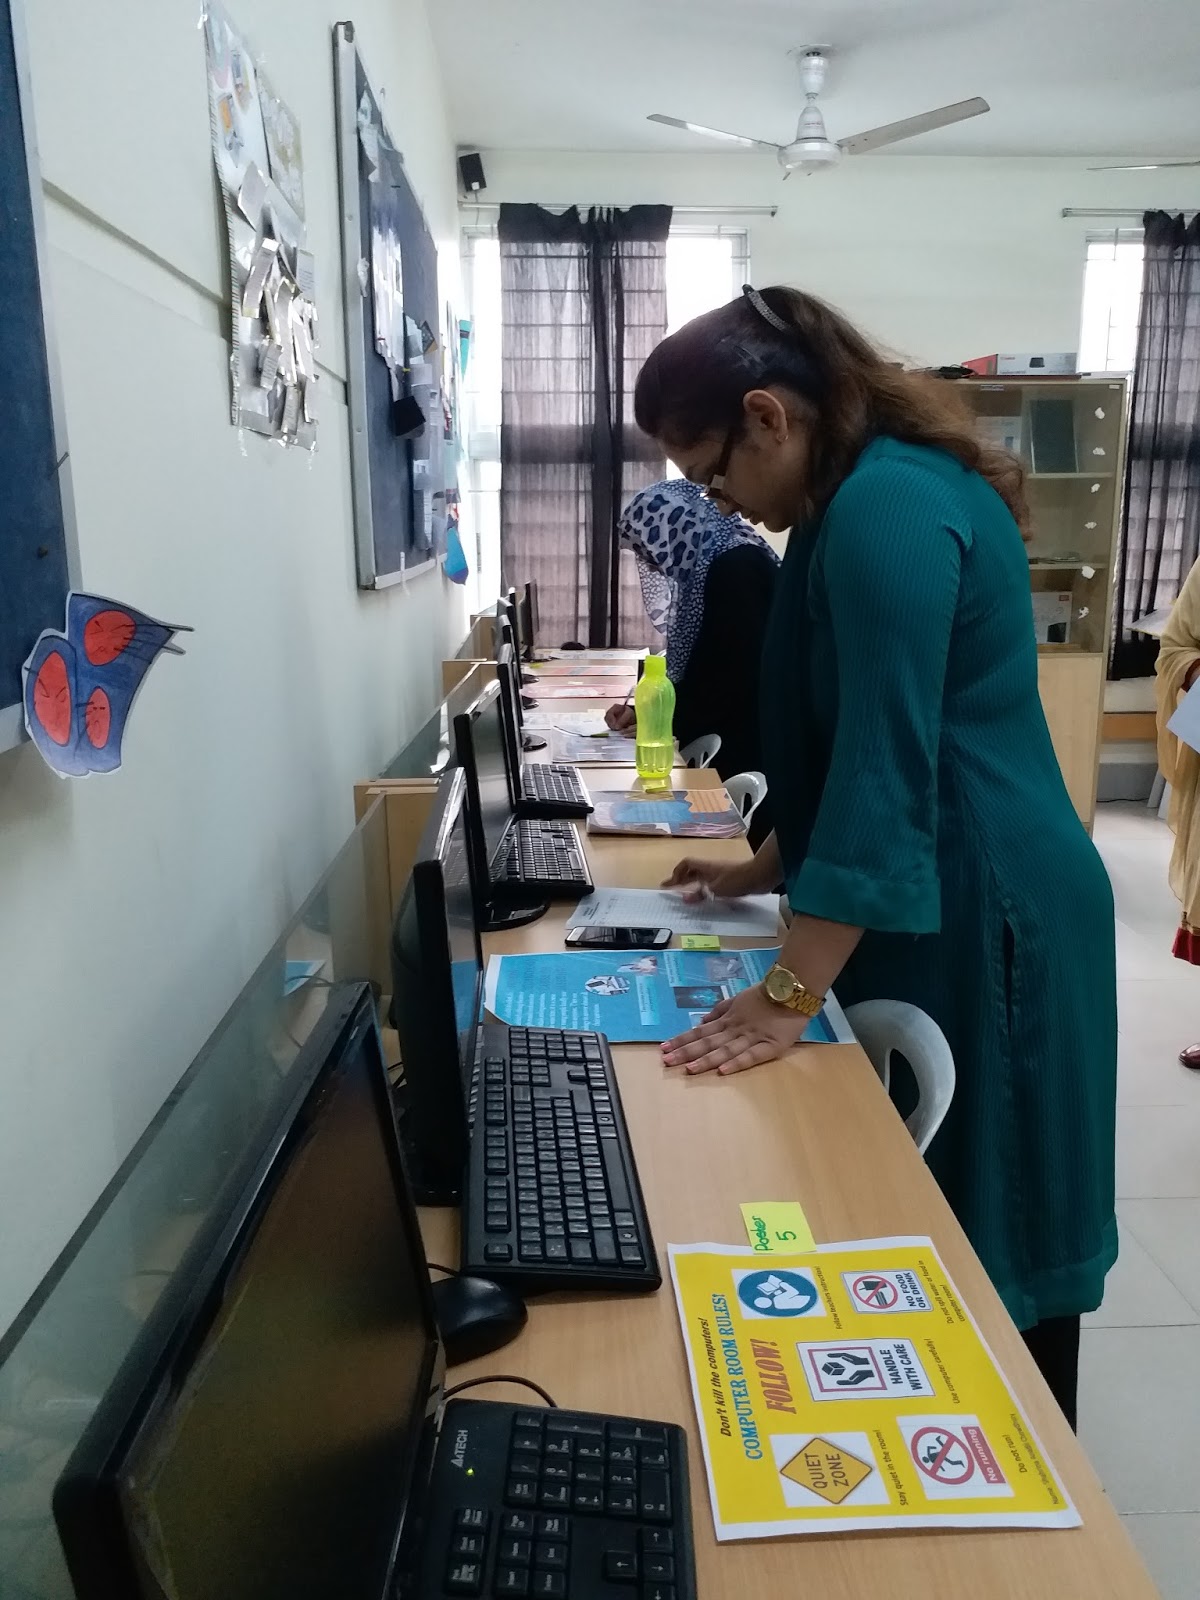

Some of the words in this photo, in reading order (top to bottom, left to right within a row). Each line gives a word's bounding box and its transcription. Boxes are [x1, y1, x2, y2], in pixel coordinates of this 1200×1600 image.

[750, 1216, 774, 1251] Poster
[776, 1231, 796, 1240] 5
[895, 1274, 910, 1293] FOOD
[903, 1272, 920, 1294] DRINK
[906, 1296, 916, 1306] NO
[914, 1297, 926, 1308] OR
[712, 1294, 734, 1336] RULES!
[698, 1318, 717, 1369] computers!
[721, 1339, 744, 1375] ROOM
[893, 1344, 912, 1365] CARE
[750, 1338, 797, 1414] FOLLOW!
[880, 1350, 903, 1384] HANDLE
[938, 1364, 955, 1391] computer
[710, 1372, 721, 1387] the
[904, 1368, 922, 1390] WITH
[713, 1389, 725, 1406] kill
[951, 1393, 960, 1404] Use
[716, 1408, 732, 1436] Don't
[730, 1379, 763, 1460] COMPUTER
[873, 1429, 886, 1449] room!
[968, 1429, 990, 1465] running
[881, 1451, 892, 1462] the
[1010, 1450, 1022, 1461] not
[804, 1453, 828, 1488] QUIET
[826, 1453, 849, 1486] ZONE
[987, 1467, 998, 1481] No
[1018, 1463, 1028, 1473] Do
[890, 1472, 904, 1489] quiet
[897, 1491, 908, 1506] Stay
